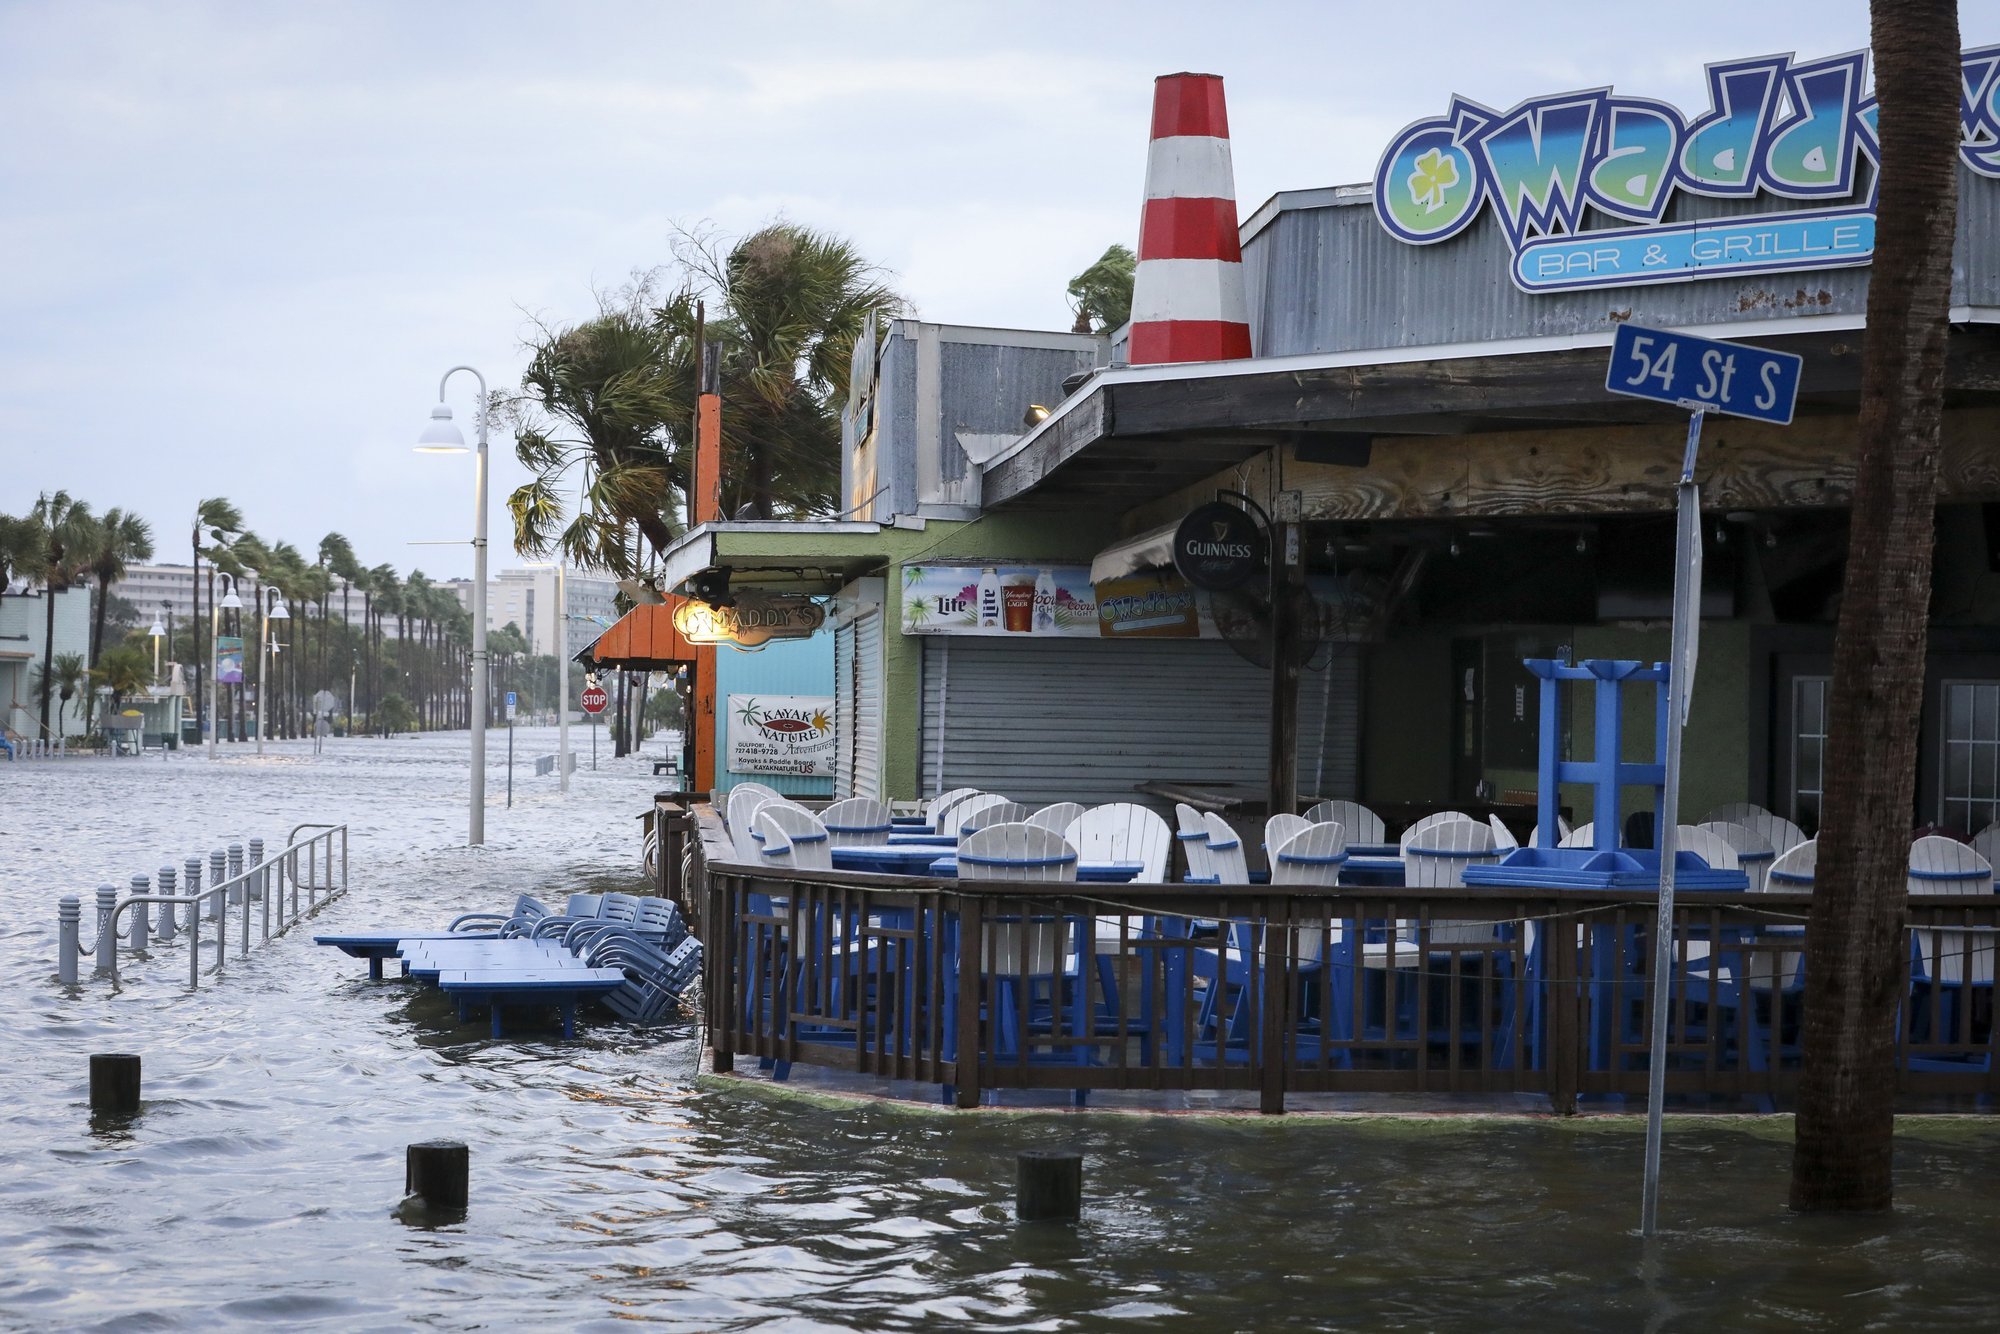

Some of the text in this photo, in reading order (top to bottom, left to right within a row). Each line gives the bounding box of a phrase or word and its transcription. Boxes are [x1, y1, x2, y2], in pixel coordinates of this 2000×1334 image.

[1538, 225, 1862, 277] BAR & GRILLE
[1625, 336, 1782, 410] 54 St S
[1186, 539, 1252, 558] GUINNESS
[982, 589, 998, 618] Lite
[1033, 589, 1056, 606] oor
[1067, 601, 1096, 611] Coors
[936, 597, 967, 616] Lite
[583, 694, 606, 706] STOP
[763, 708, 811, 722] KAYAK
[758, 727, 819, 744] NATURE
[738, 757, 762, 765] Kayaks
